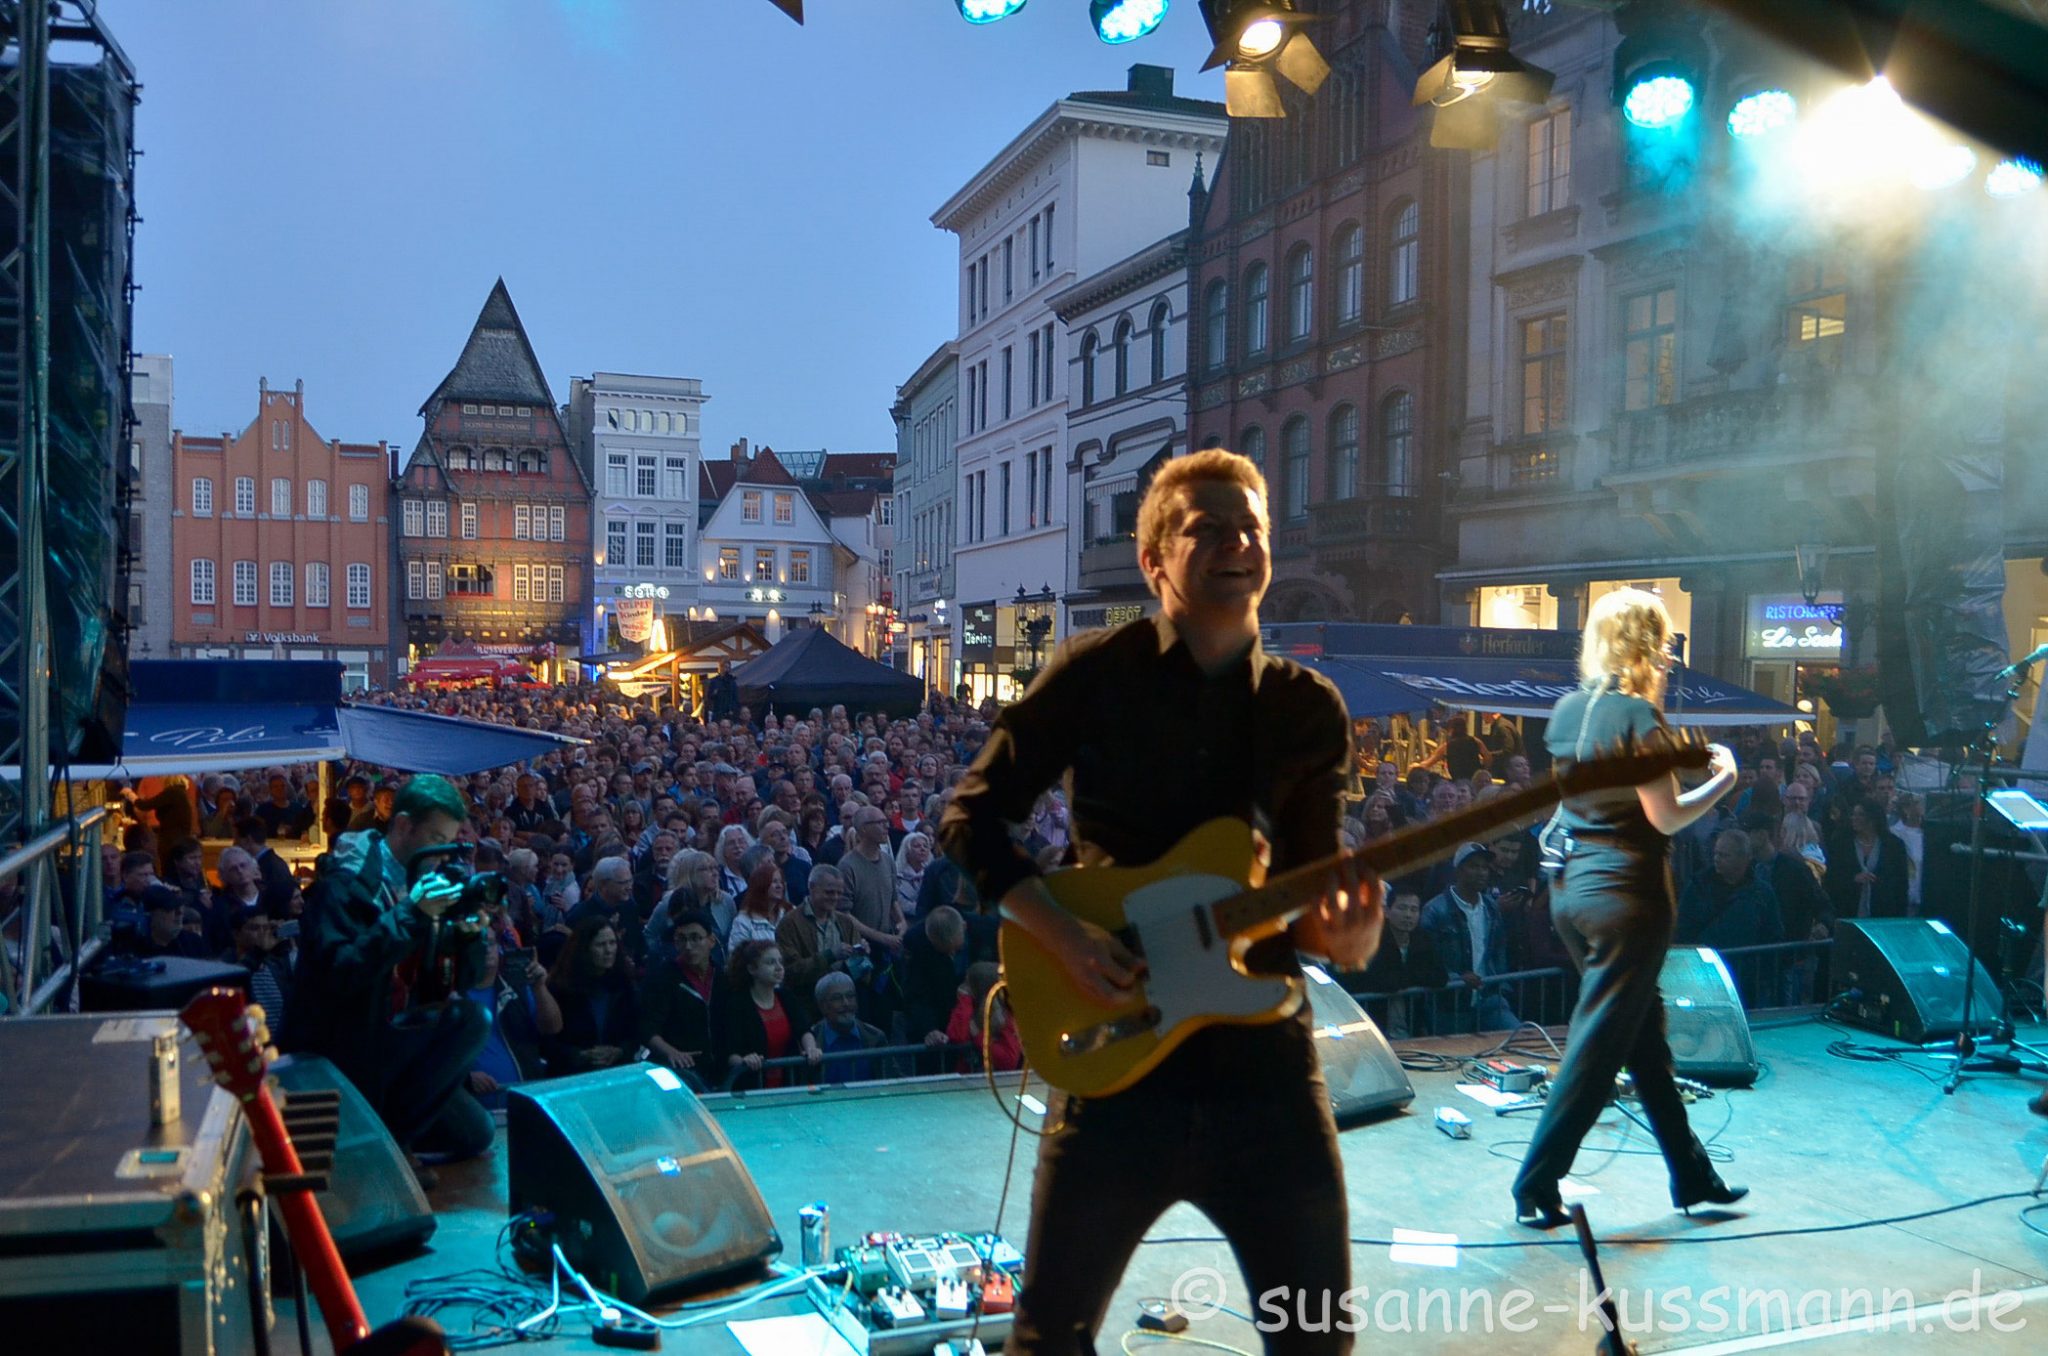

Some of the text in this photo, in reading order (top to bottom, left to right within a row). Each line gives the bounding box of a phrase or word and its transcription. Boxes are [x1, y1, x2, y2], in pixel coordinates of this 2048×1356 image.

[263, 632, 319, 643] Volksbank
[1797, 626, 1843, 648] Scal
[1424, 676, 1578, 699] Herfor
